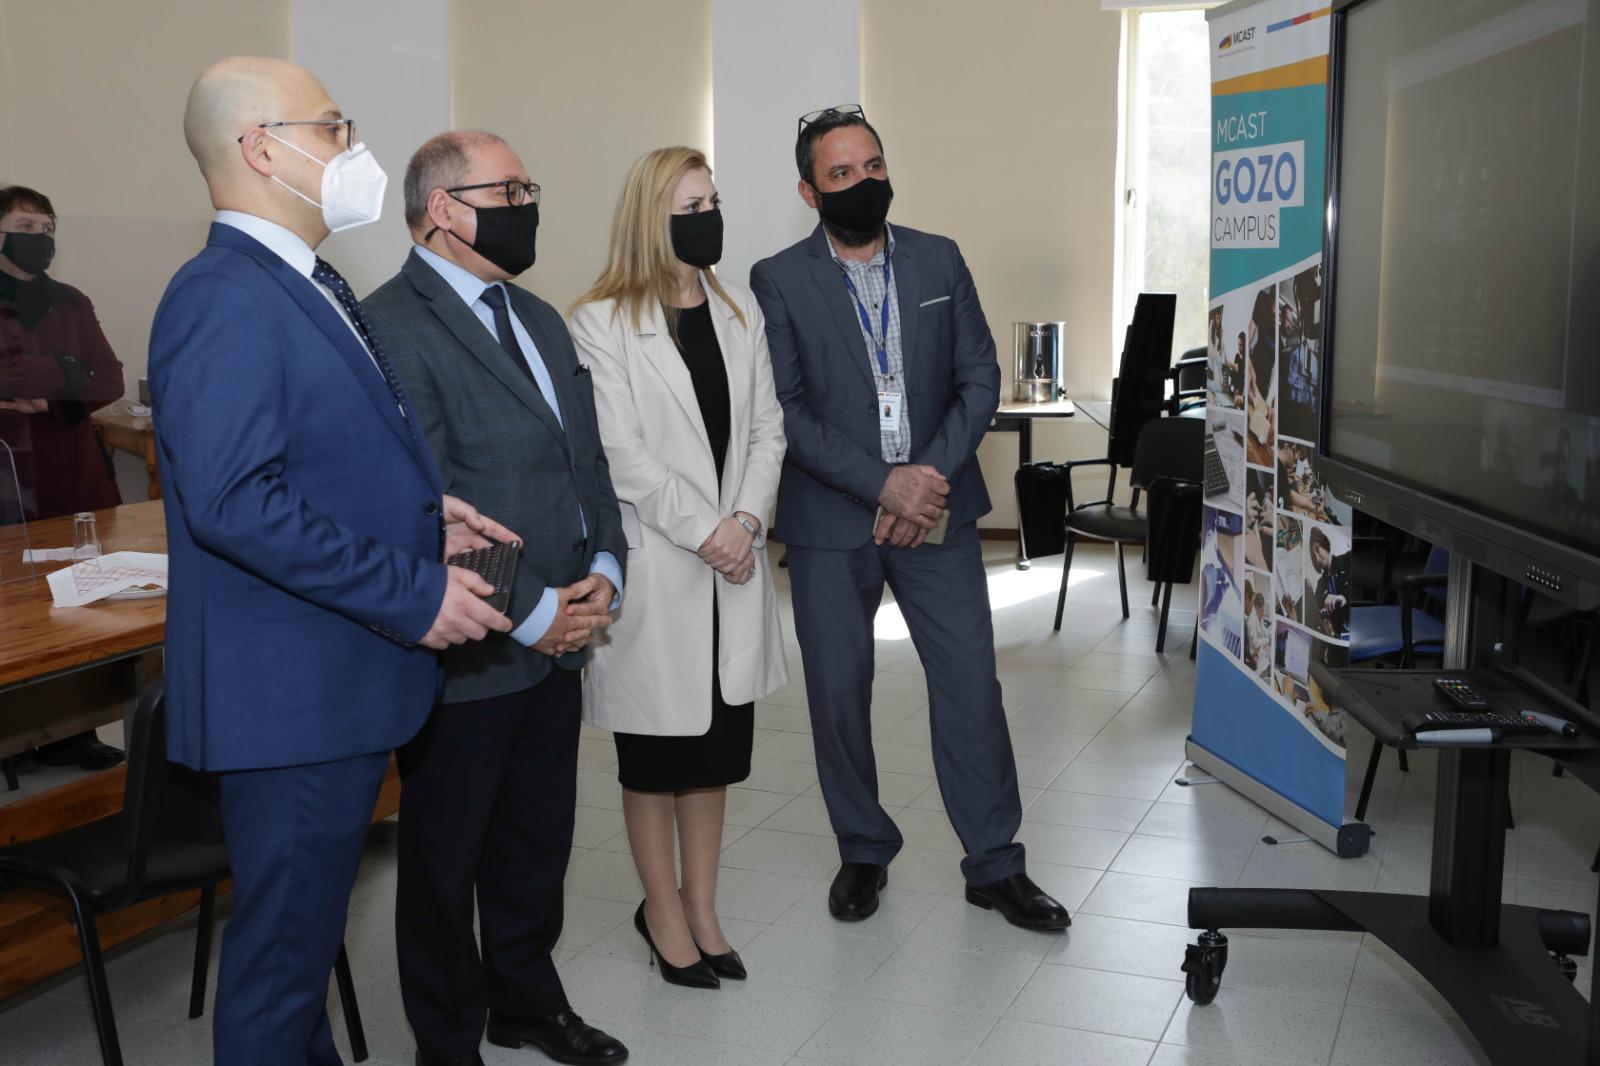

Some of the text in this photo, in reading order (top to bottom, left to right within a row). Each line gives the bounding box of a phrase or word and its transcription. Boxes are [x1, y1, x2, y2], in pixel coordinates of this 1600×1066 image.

[1232, 26, 1256, 44] MCAST
[1217, 111, 1267, 144] MCAST
[1215, 151, 1297, 205] GOZO
[1214, 214, 1276, 242] CAMPUS
